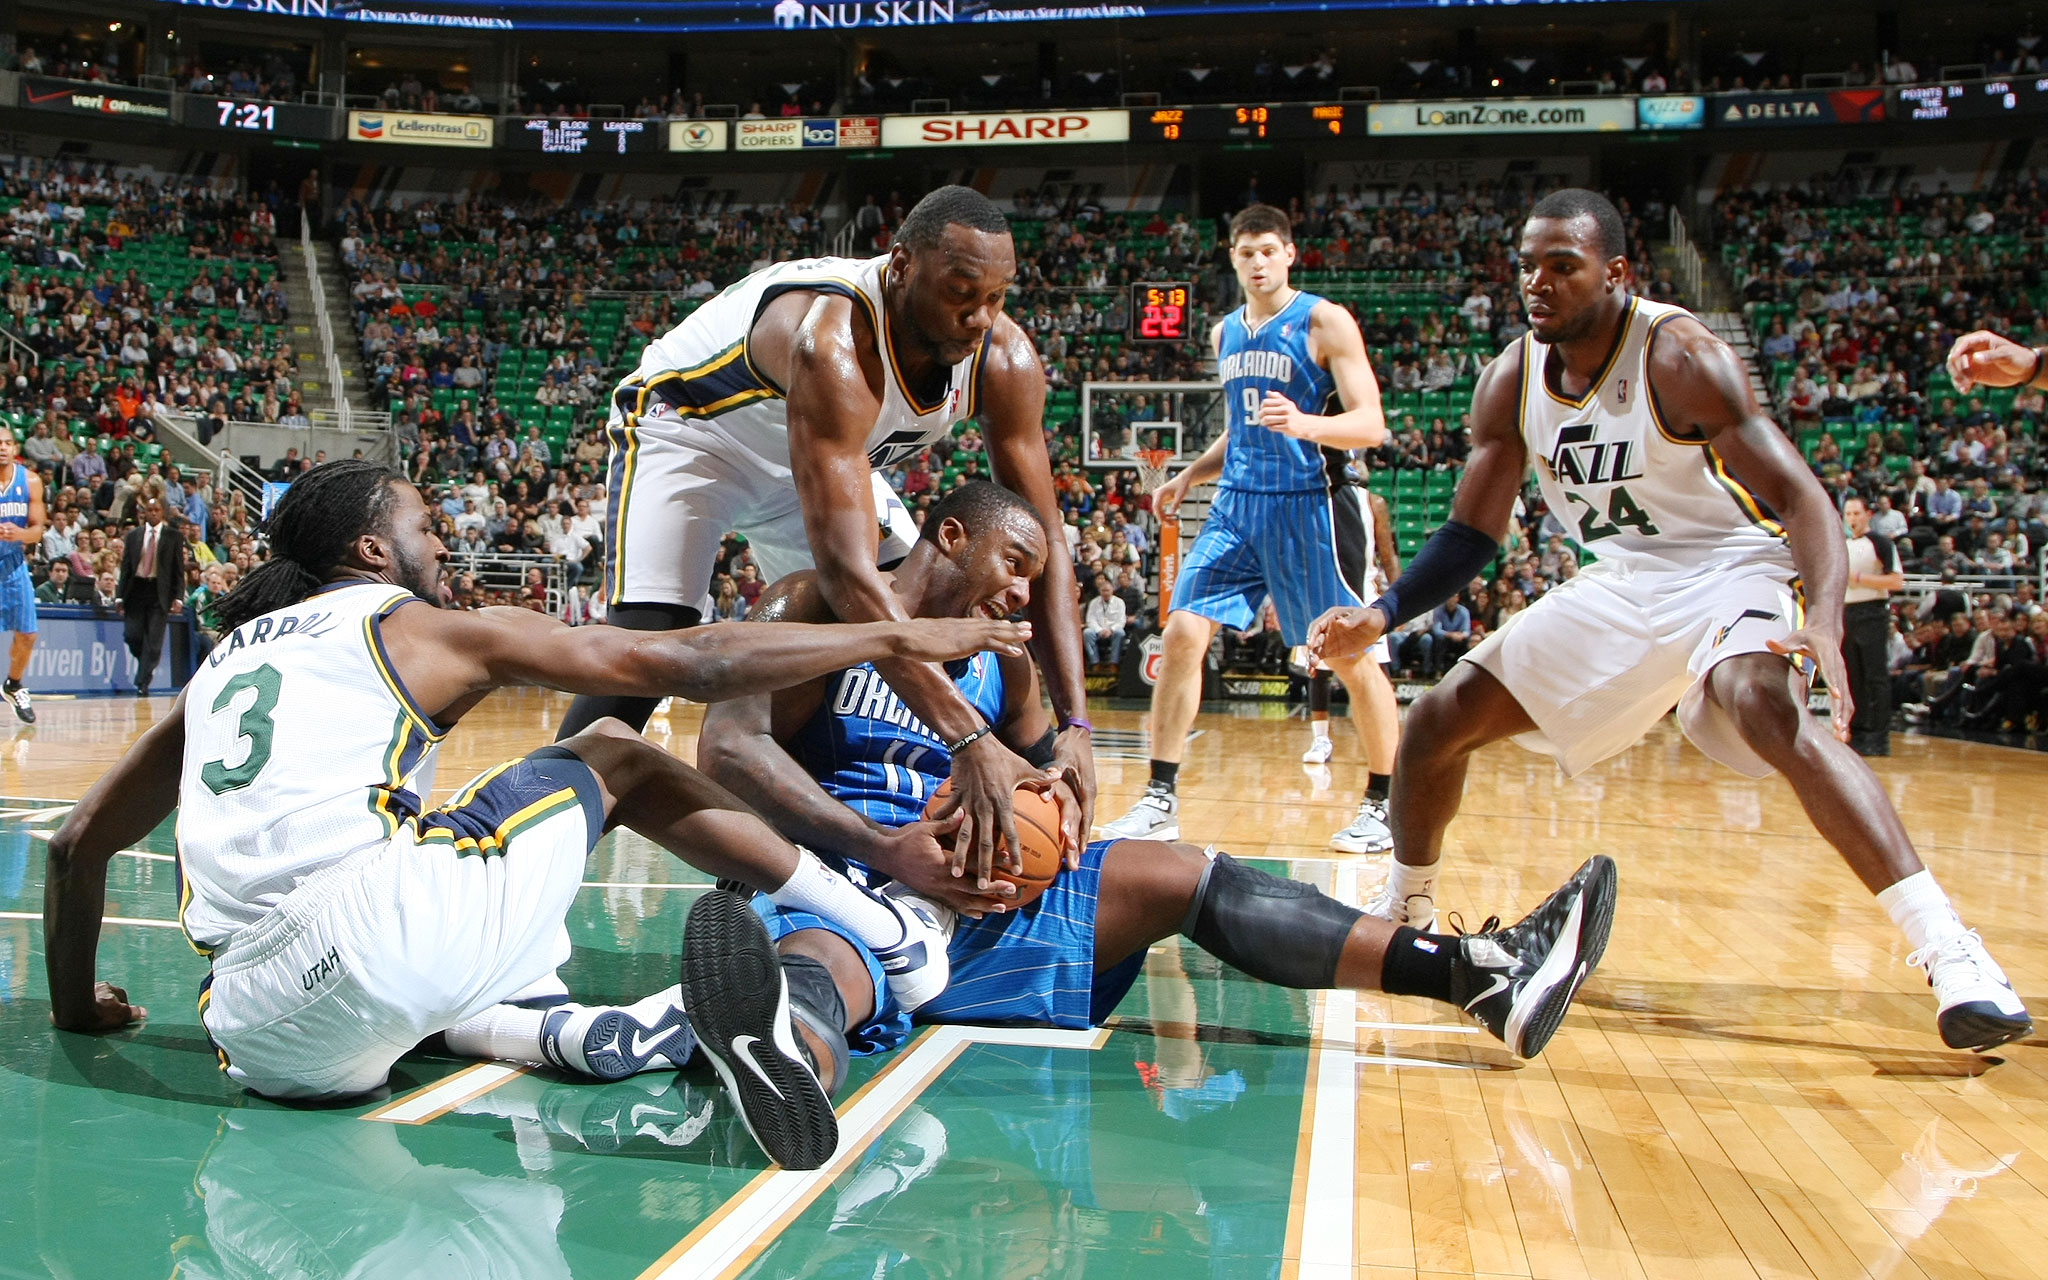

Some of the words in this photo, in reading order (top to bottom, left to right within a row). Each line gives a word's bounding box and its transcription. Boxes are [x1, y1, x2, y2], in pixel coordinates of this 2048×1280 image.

[810, 3, 861, 28] NU
[874, 0, 954, 27] SKIN
[1900, 87, 1943, 100] POINTS
[1948, 85, 1963, 98] IN
[217, 101, 275, 131] 7:21
[1151, 109, 1184, 123] JAZZ
[1312, 106, 1344, 119] MAGIC
[1416, 106, 1585, 126] LoanZone.com
[1747, 101, 1820, 119] DELTA
[1912, 106, 1948, 119] PAINT
[396, 119, 463, 134] Kellerstrass
[525, 120, 549, 130] JAZZ
[560, 121, 589, 130] BLOCK
[603, 121, 643, 132] LEADERS
[741, 122, 797, 133] SHARP
[922, 116, 1090, 142] SHARP
[742, 136, 795, 146] COPIERS
[1351, 161, 1402, 179] WE
[1408, 159, 1475, 179] ARE
[1147, 288, 1186, 307] 5:13
[1141, 305, 1182, 337] 22
[1219, 350, 1292, 385] ORLANDO
[1242, 386, 1262, 426] 9
[1536, 424, 1644, 486] JAZZ
[1564, 485, 1661, 544] 24
[28, 640, 85, 677] riven
[91, 642, 118, 684] By
[1229, 680, 1291, 696] SUBWAY
[200, 662, 283, 796] 3
[882, 739, 930, 800] 11
[302, 945, 340, 991] UTAH
